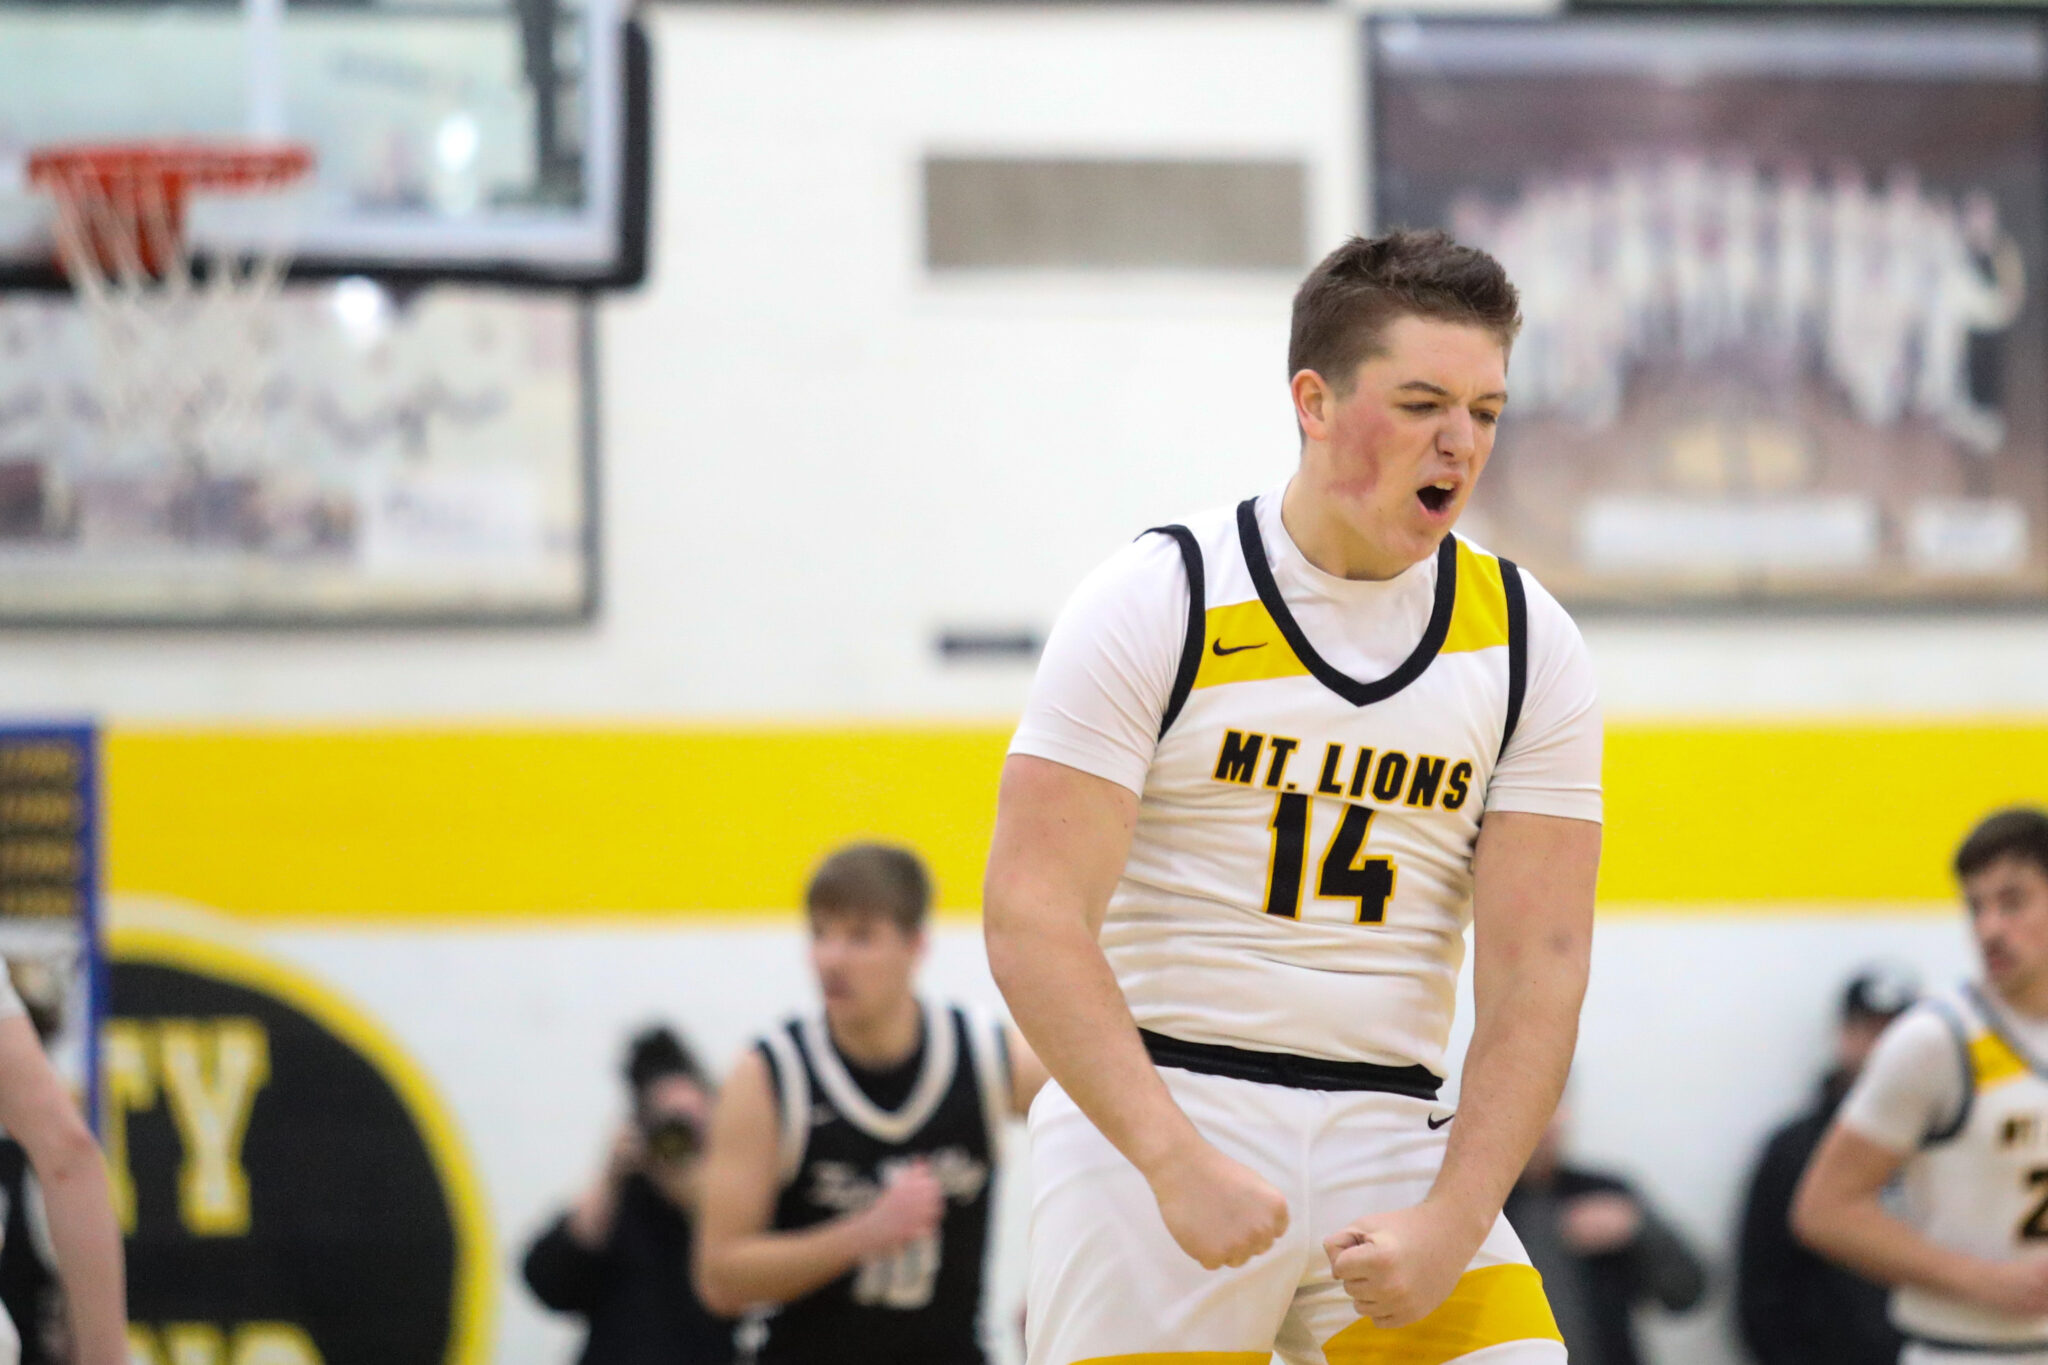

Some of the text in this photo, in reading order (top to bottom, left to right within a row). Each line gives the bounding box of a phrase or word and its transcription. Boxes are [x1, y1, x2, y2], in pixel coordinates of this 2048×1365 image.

[1211, 727, 1473, 813] MT. LIONS
[1263, 791, 1398, 926] 14
